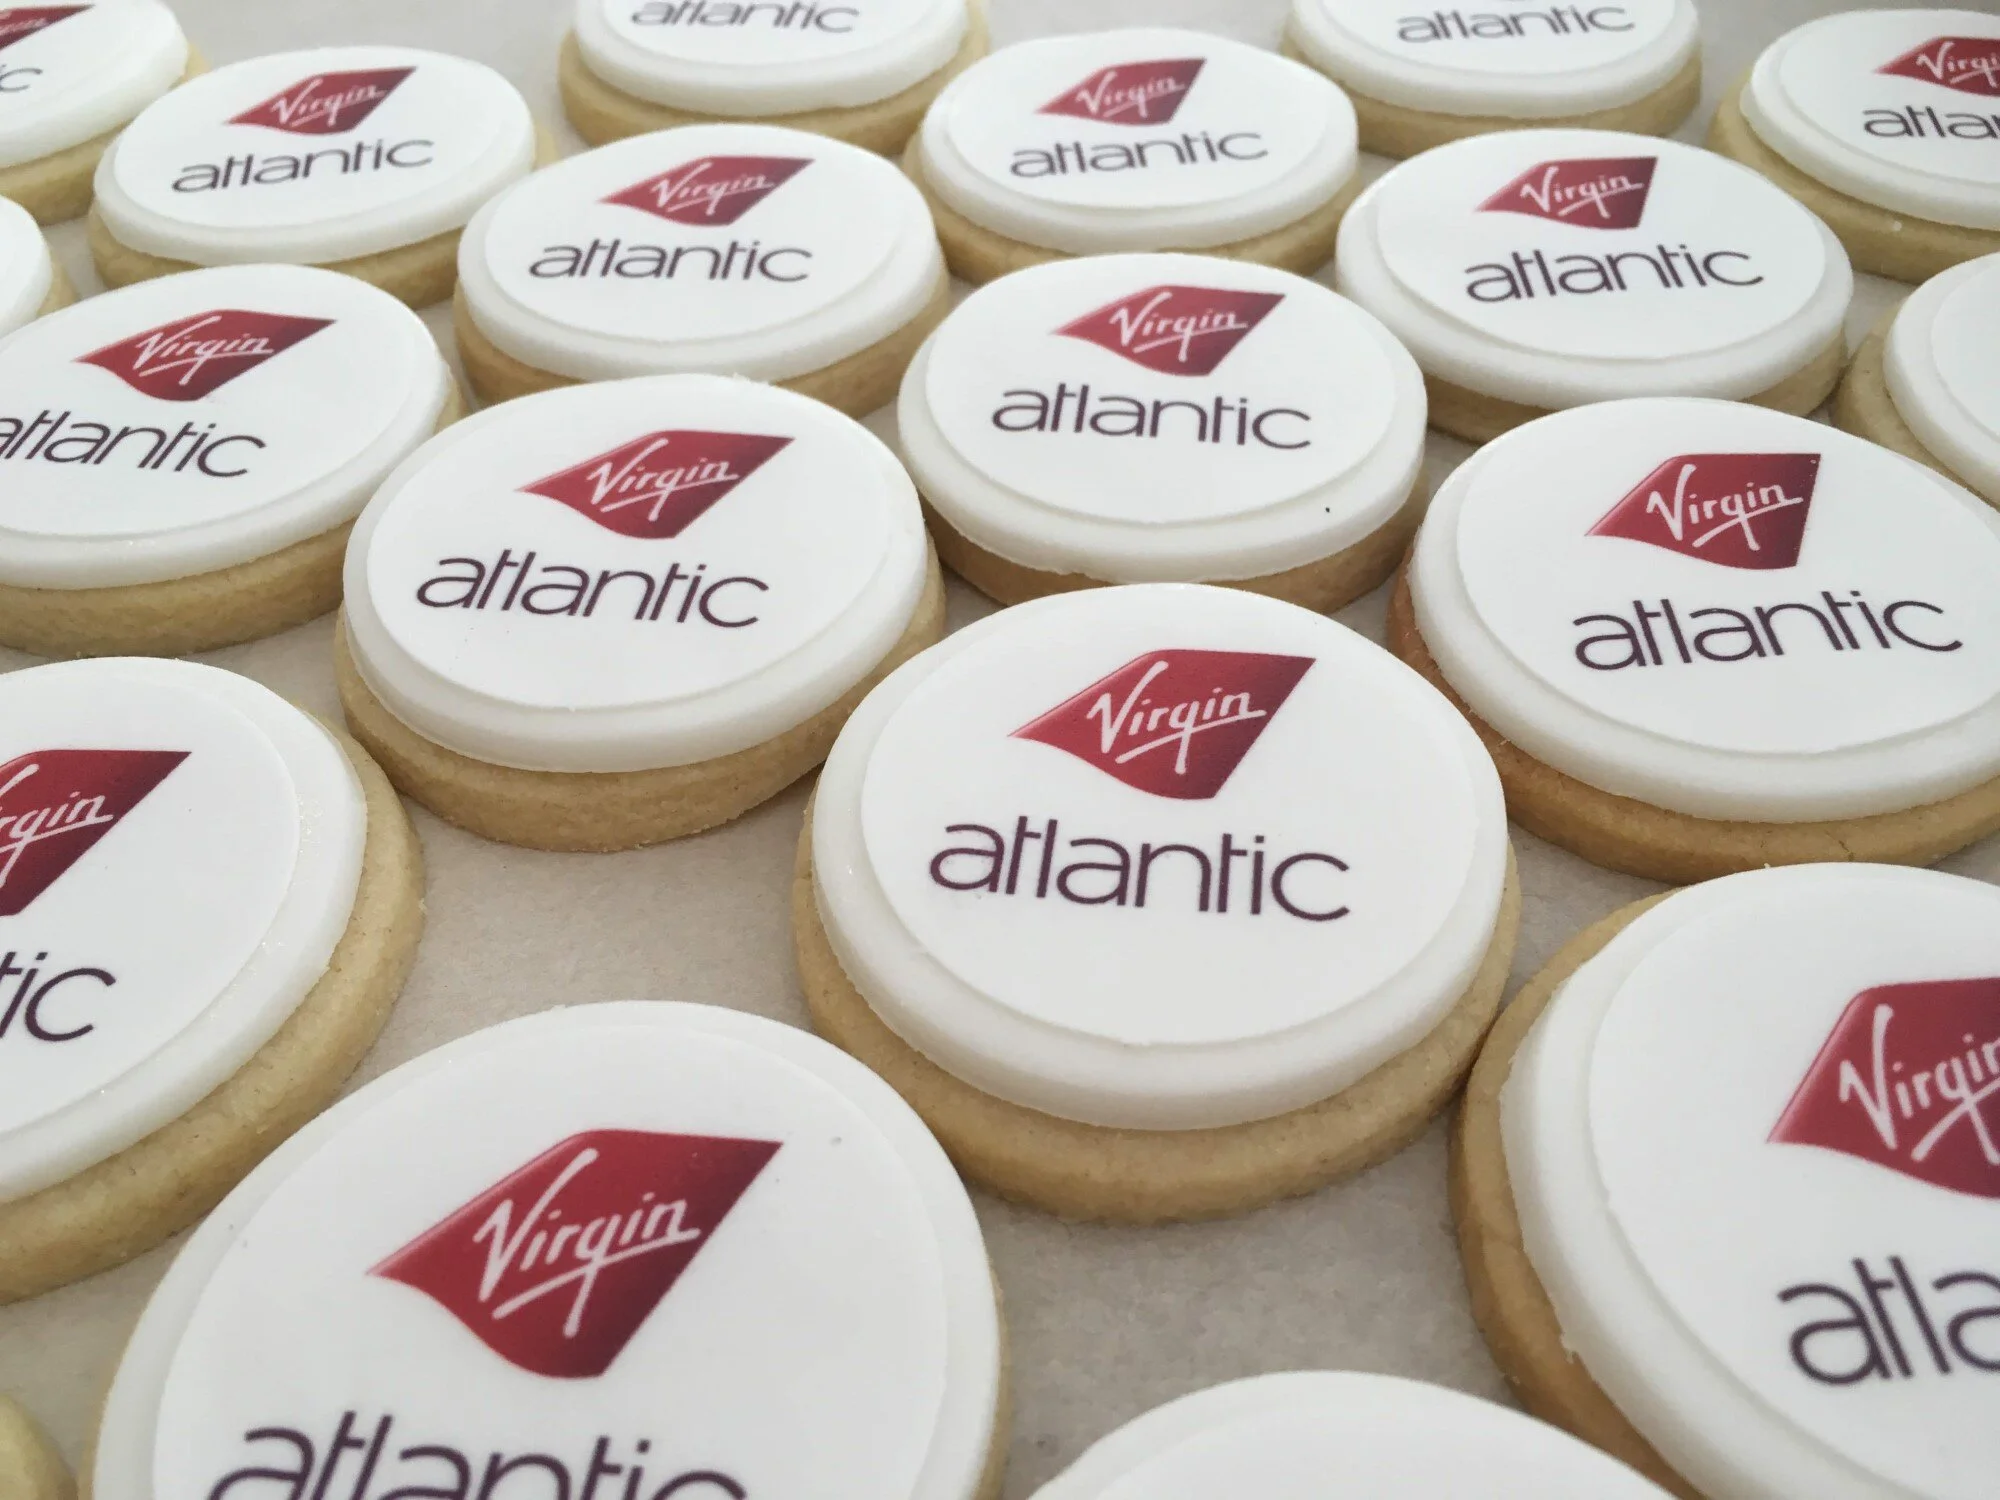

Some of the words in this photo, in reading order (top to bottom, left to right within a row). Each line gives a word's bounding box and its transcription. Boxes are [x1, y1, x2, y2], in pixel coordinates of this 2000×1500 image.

[1396, 5, 1635, 43] atlantic
[270, 78, 386, 127] Virgin
[1075, 70, 1186, 119] Virgin
[1862, 105, 2000, 140] atla
[172, 138, 435, 193] atlantic
[650, 160, 777, 216] Virgin
[1010, 131, 1269, 178] atlantic
[1519, 166, 1644, 219] Virgin
[529, 239, 812, 283] atlantic
[1465, 243, 1764, 303] atlantic
[132, 315, 275, 386] Virgin
[1108, 290, 1248, 363] Virgin
[992, 382, 1311, 450] atlantic
[586, 437, 739, 522] Virgin
[1645, 464, 1804, 551] Virgin
[416, 549, 770, 629] atlantic
[1572, 589, 1964, 672] atlantic
[1086, 660, 1268, 776] Virgin
[0, 763, 115, 889] rgin
[928, 815, 1350, 922] atlantic
[473, 1148, 701, 1337] Virgin
